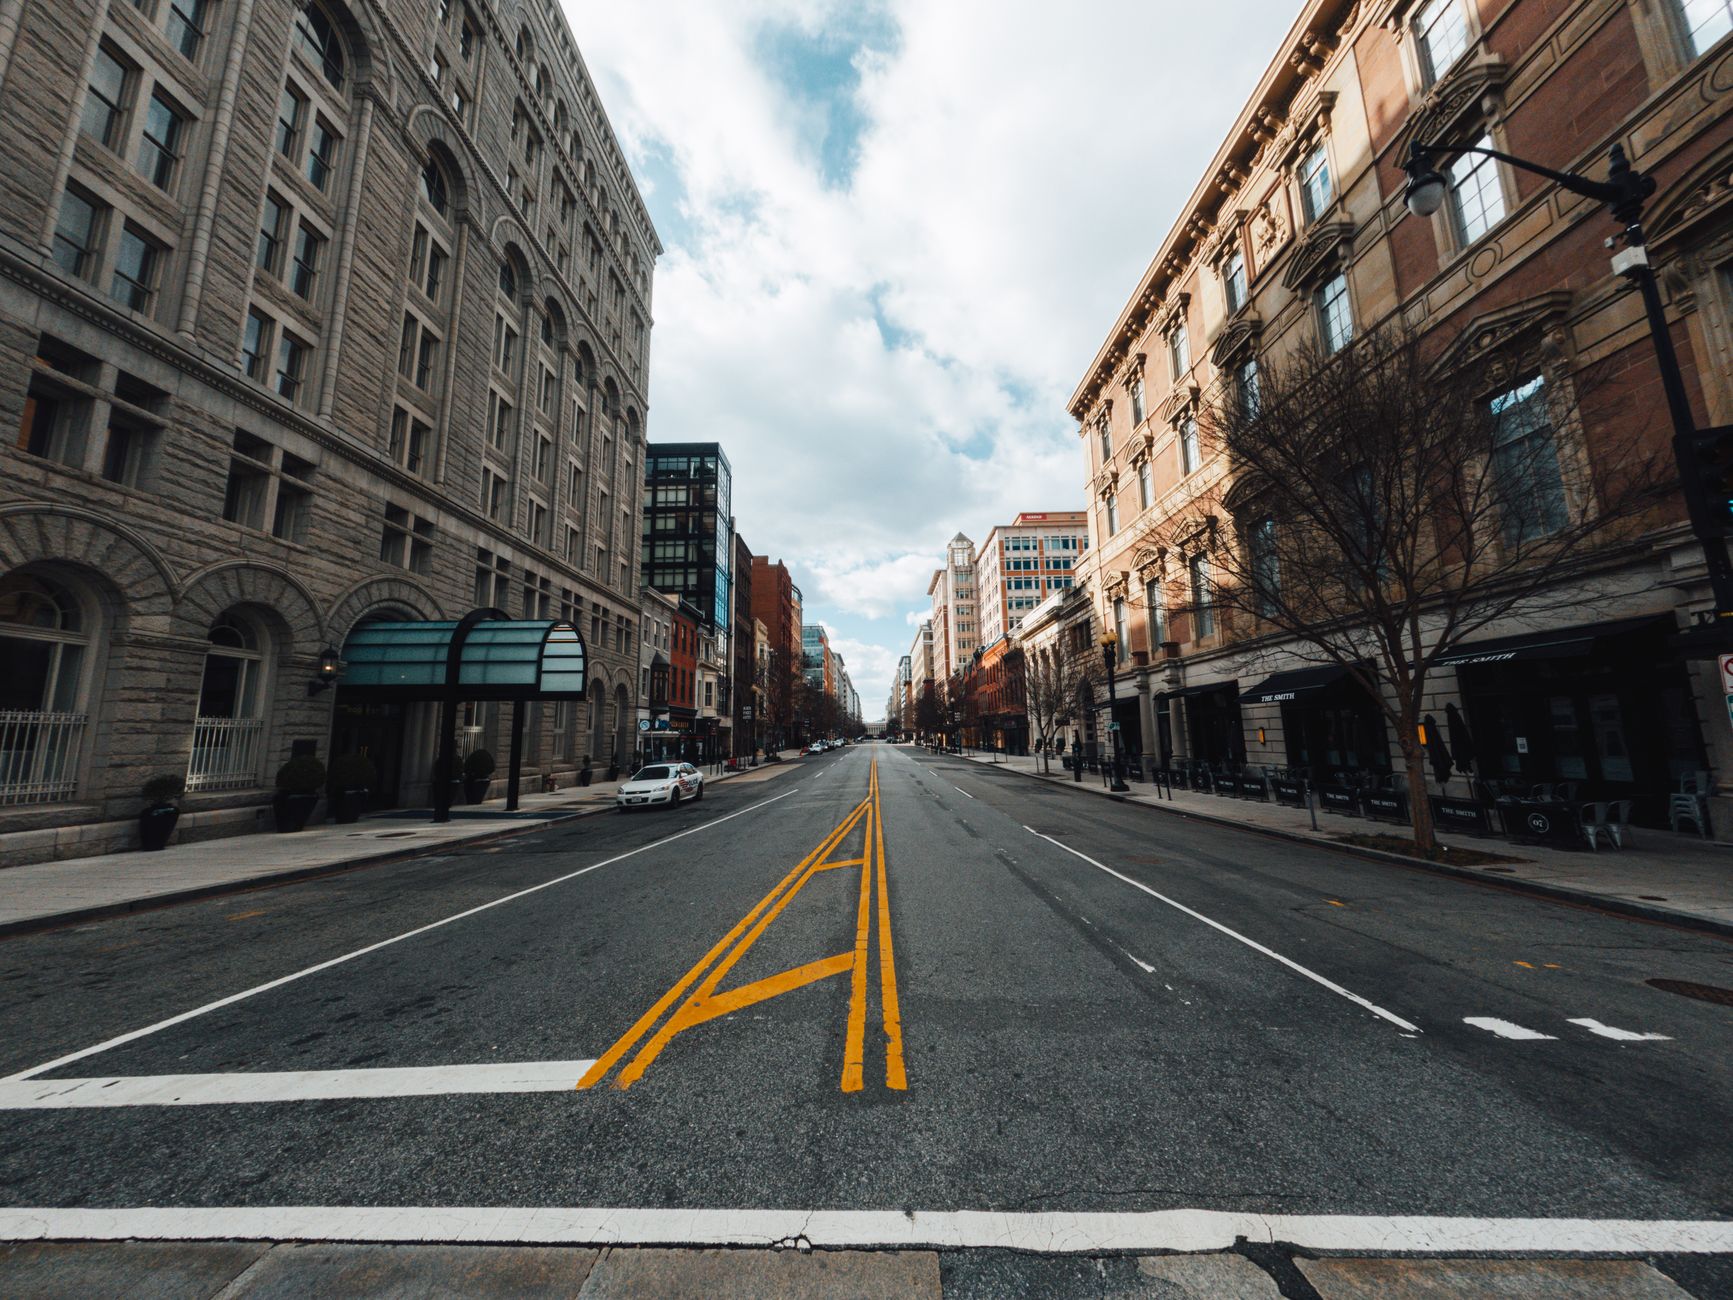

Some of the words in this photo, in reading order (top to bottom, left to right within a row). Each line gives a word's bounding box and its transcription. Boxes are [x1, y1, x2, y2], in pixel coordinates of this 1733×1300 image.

[1469, 652, 1517, 664] SMITH
[1274, 692, 1295, 700] SMITH
[1441, 807, 1454, 815] THE
[1455, 809, 1477, 818] SMITH
